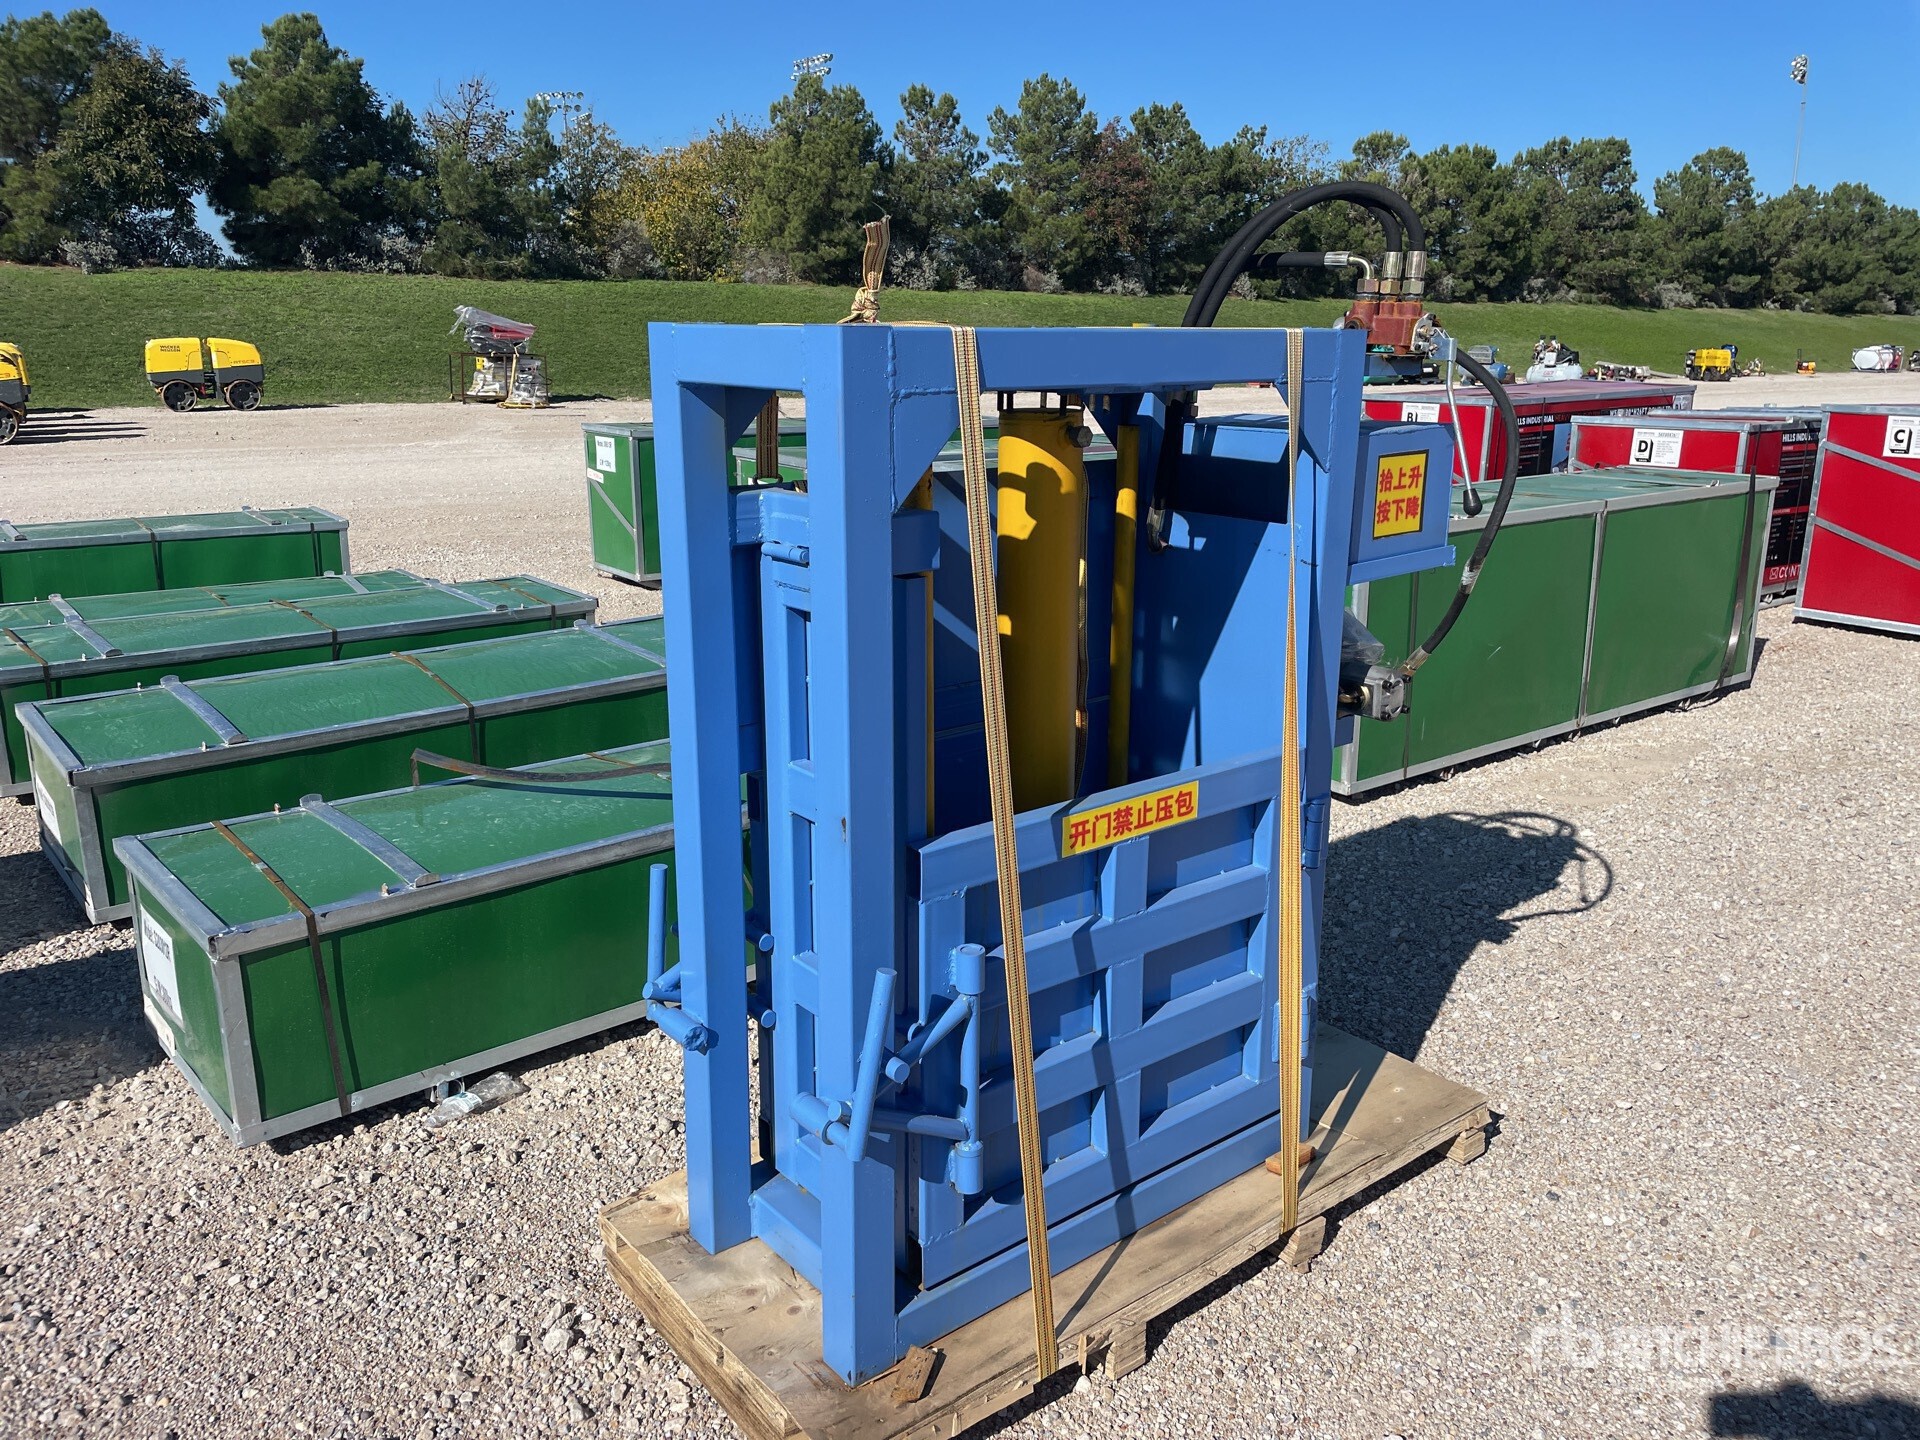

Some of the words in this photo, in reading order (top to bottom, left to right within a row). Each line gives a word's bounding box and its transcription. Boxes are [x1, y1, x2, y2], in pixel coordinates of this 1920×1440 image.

[1638, 440, 1649, 453] D
[1893, 429, 1906, 444] C
[1380, 465, 1422, 493] 抬上升
[1376, 495, 1420, 524] 按下降
[1069, 790, 1194, 849] 开门禁止压包
